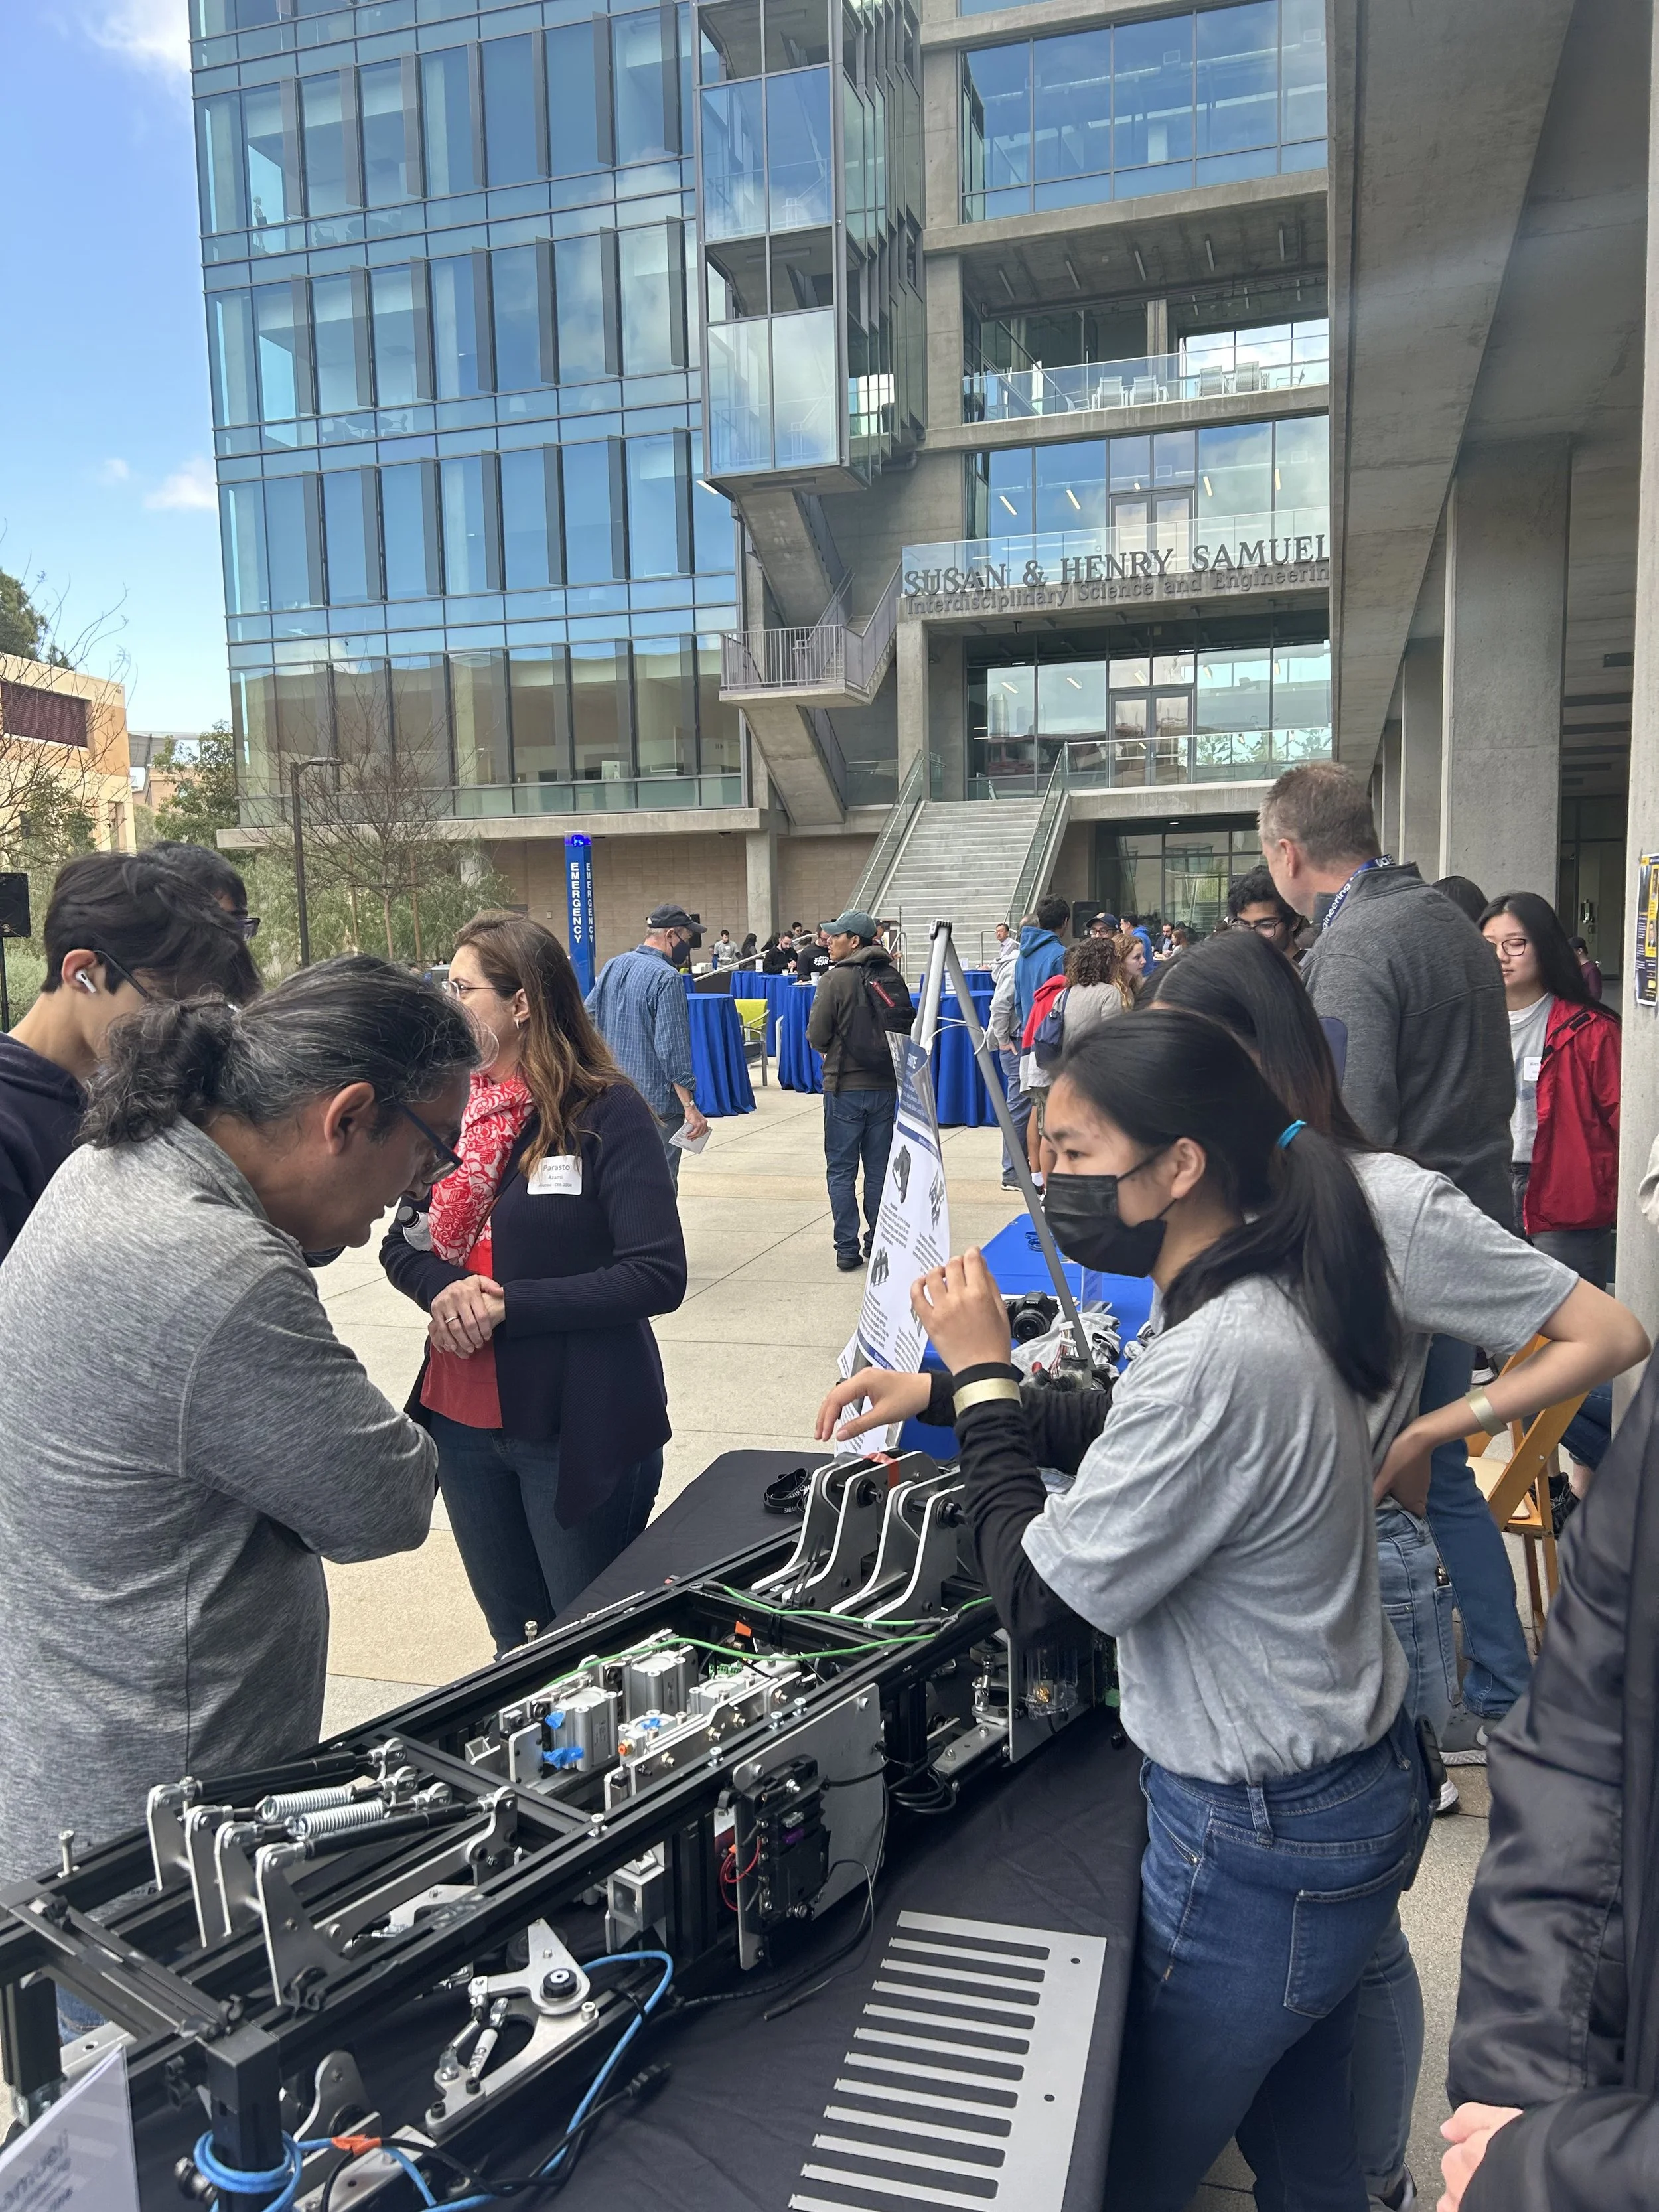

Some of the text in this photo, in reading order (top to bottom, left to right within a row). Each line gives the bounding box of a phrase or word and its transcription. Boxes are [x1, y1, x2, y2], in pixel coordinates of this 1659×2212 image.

[904, 564, 1006, 597] SUSAN
[1023, 559, 1046, 587] &
[1061, 548, 1174, 585] HENRY
[908, 587, 1067, 615] Interdisciplinary
[1078, 581, 1154, 601] Science
[1164, 573, 1202, 594] and
[571, 862, 582, 943] EMERGENCY
[586, 862, 595, 943] EMERGENCY
